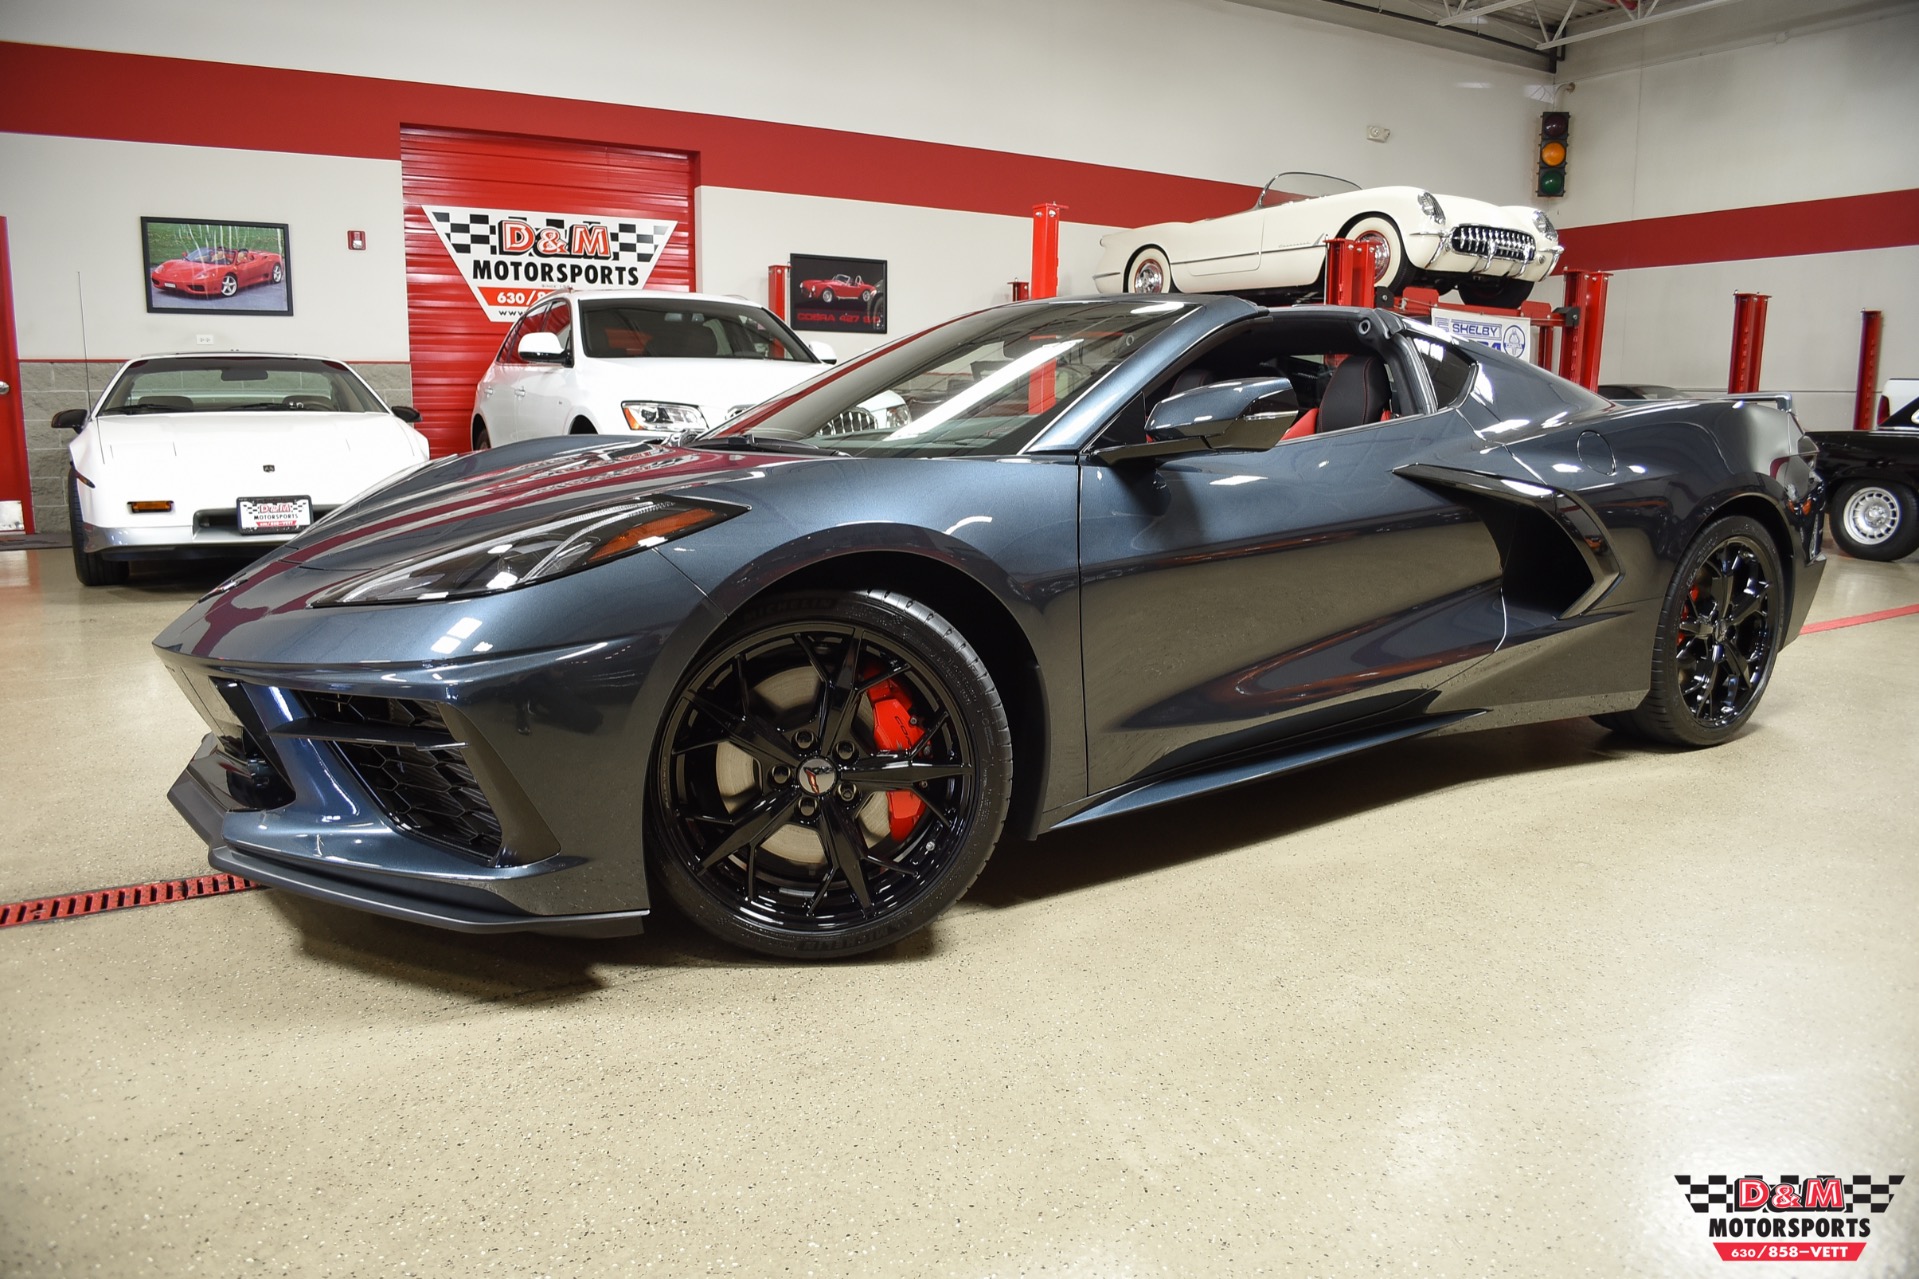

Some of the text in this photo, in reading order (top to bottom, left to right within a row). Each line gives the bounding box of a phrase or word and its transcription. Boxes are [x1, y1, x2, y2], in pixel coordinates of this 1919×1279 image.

[498, 220, 611, 259] D&M
[472, 260, 639, 286] MOTORSPORTS
[1452, 323, 1498, 337] SHELBY
[254, 513, 299, 521] MOTORSPORTS
